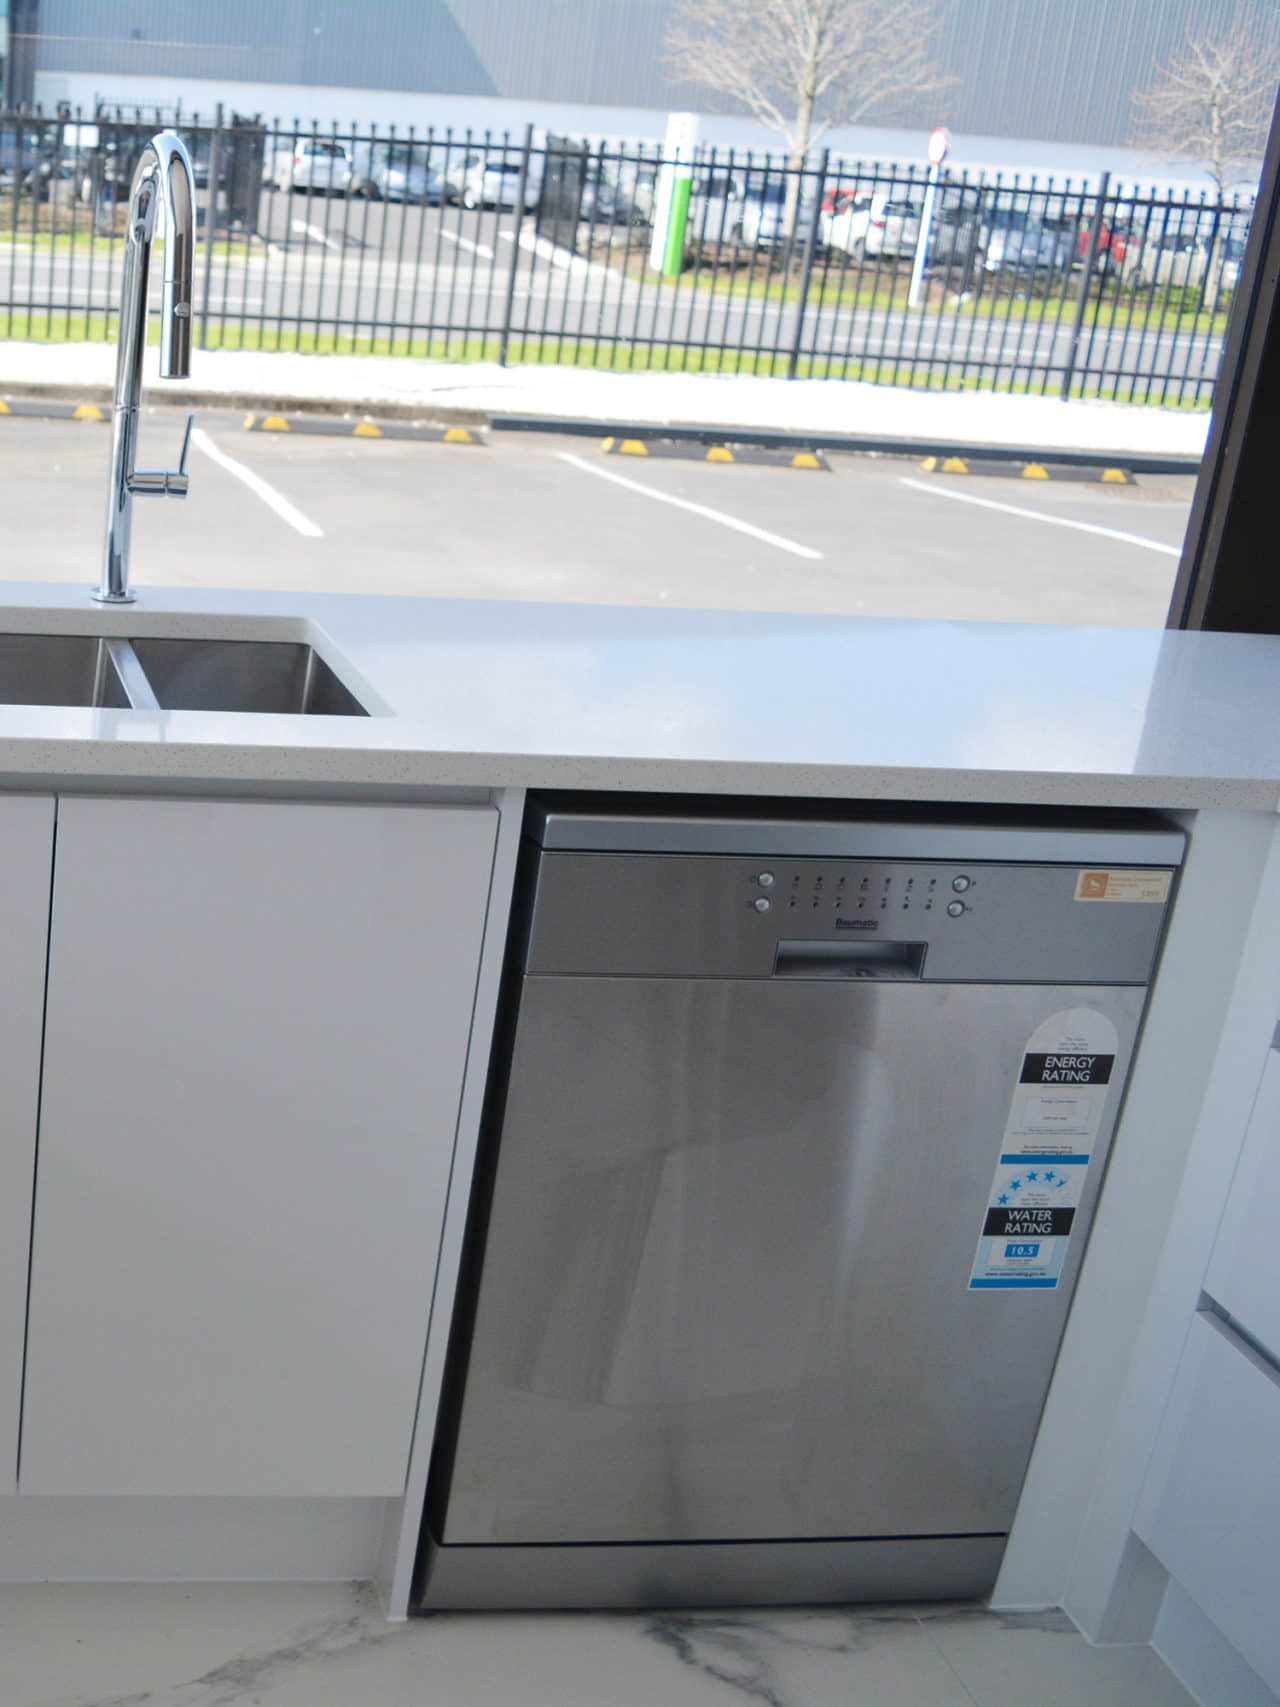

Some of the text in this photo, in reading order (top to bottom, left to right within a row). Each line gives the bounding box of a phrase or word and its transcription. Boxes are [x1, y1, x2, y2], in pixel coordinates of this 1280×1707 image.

[1044, 1055, 1096, 1069] ENERGY
[1041, 1069, 1091, 1082] RATING
[1007, 1209, 1053, 1221] WATER
[1004, 1222, 1053, 1234] RATING
[1011, 1246, 1035, 1256] 10.5
